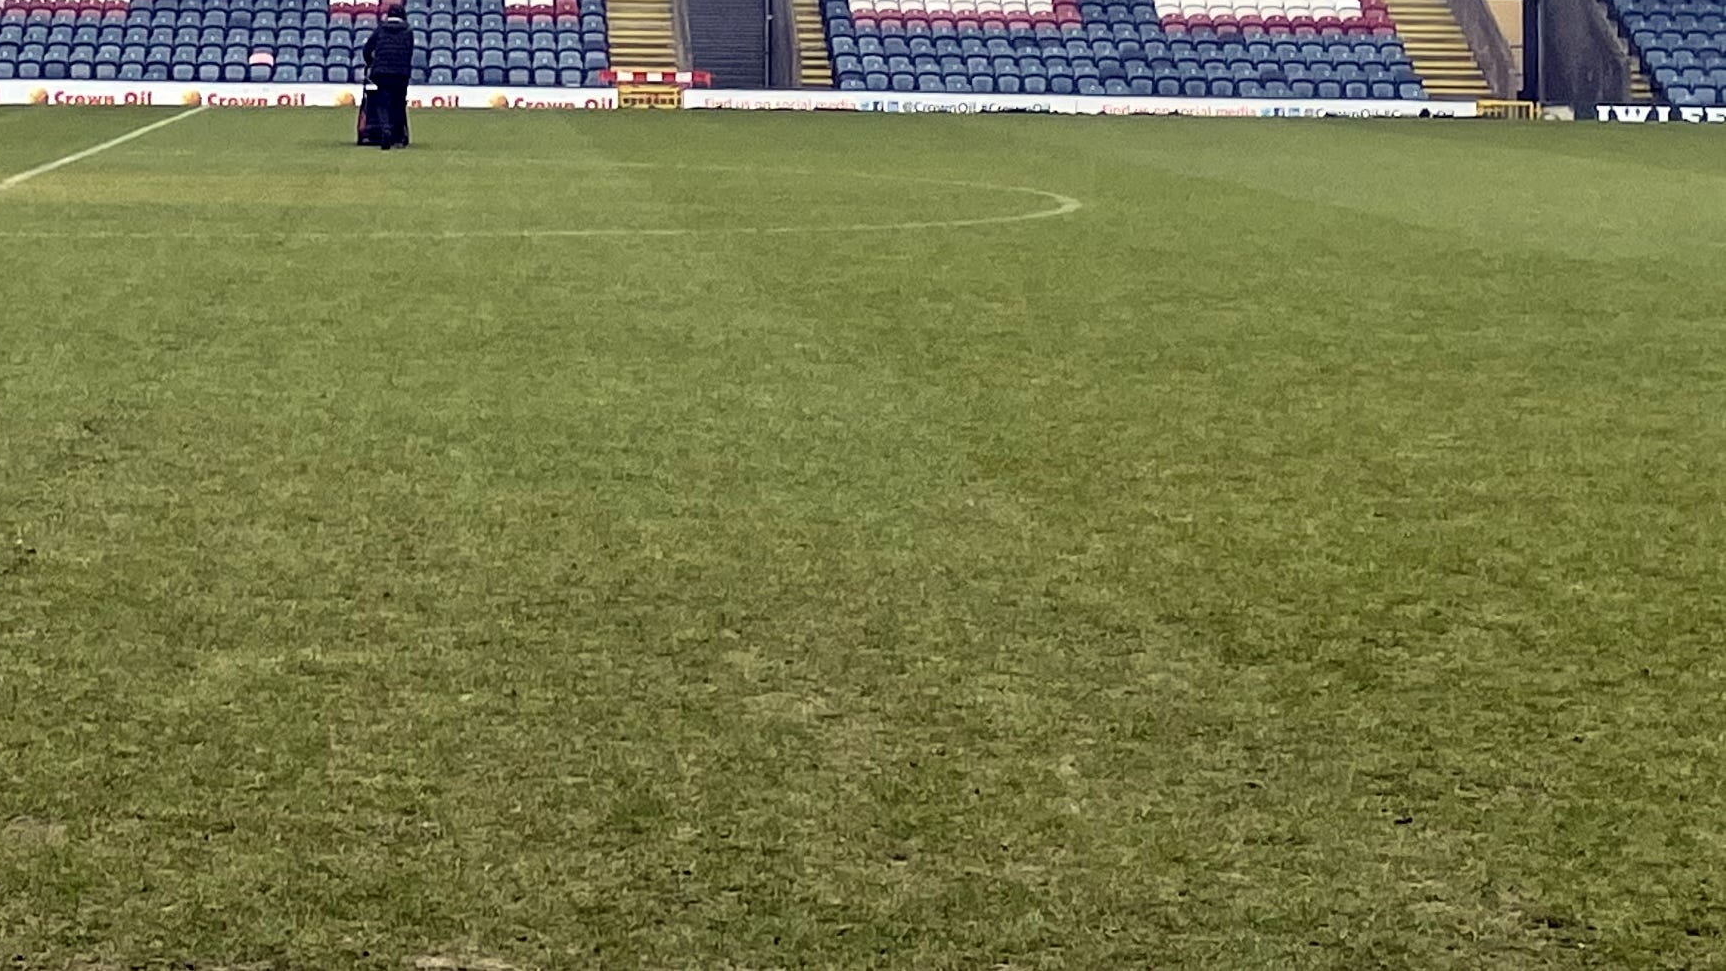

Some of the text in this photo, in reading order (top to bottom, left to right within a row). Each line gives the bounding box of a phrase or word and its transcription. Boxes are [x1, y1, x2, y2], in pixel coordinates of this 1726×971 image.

[54, 91, 153, 105] Crown Oil
[207, 93, 306, 107] Crown Oil
[431, 96, 460, 108] Oil
[585, 98, 614, 109] Oil
